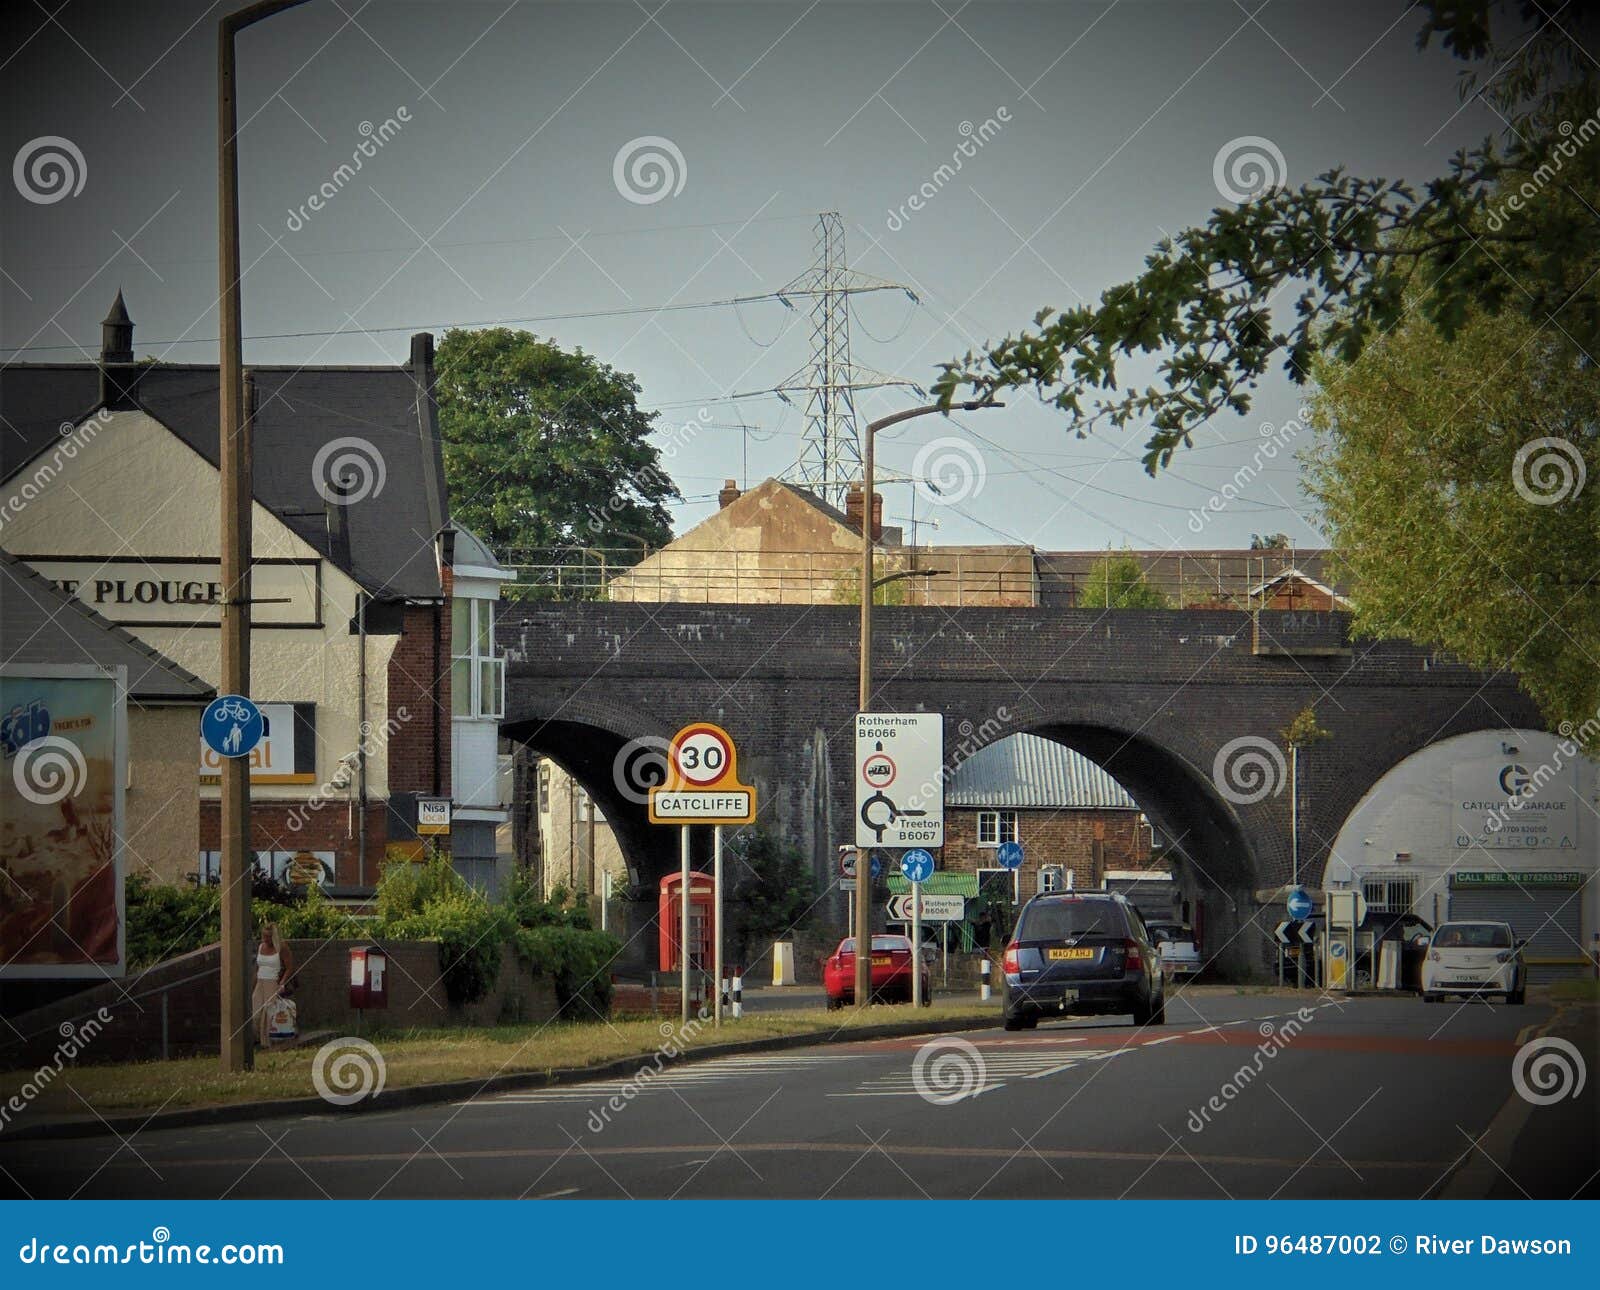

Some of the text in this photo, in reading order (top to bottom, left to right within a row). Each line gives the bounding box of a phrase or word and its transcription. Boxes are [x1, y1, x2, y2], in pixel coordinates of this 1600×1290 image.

[859, 717, 917, 726] Rotherham
[859, 729, 896, 738] B6066
[682, 746, 722, 769] 30
[423, 803, 445, 813] Nisa
[661, 799, 742, 810] CATCLIFFE
[1522, 801, 1566, 810] GARAGE
[900, 820, 940, 829] Treeton
[900, 831, 936, 840] B6067
[1458, 873, 1481, 881] CALL
[1484, 873, 1505, 881] NEIL
